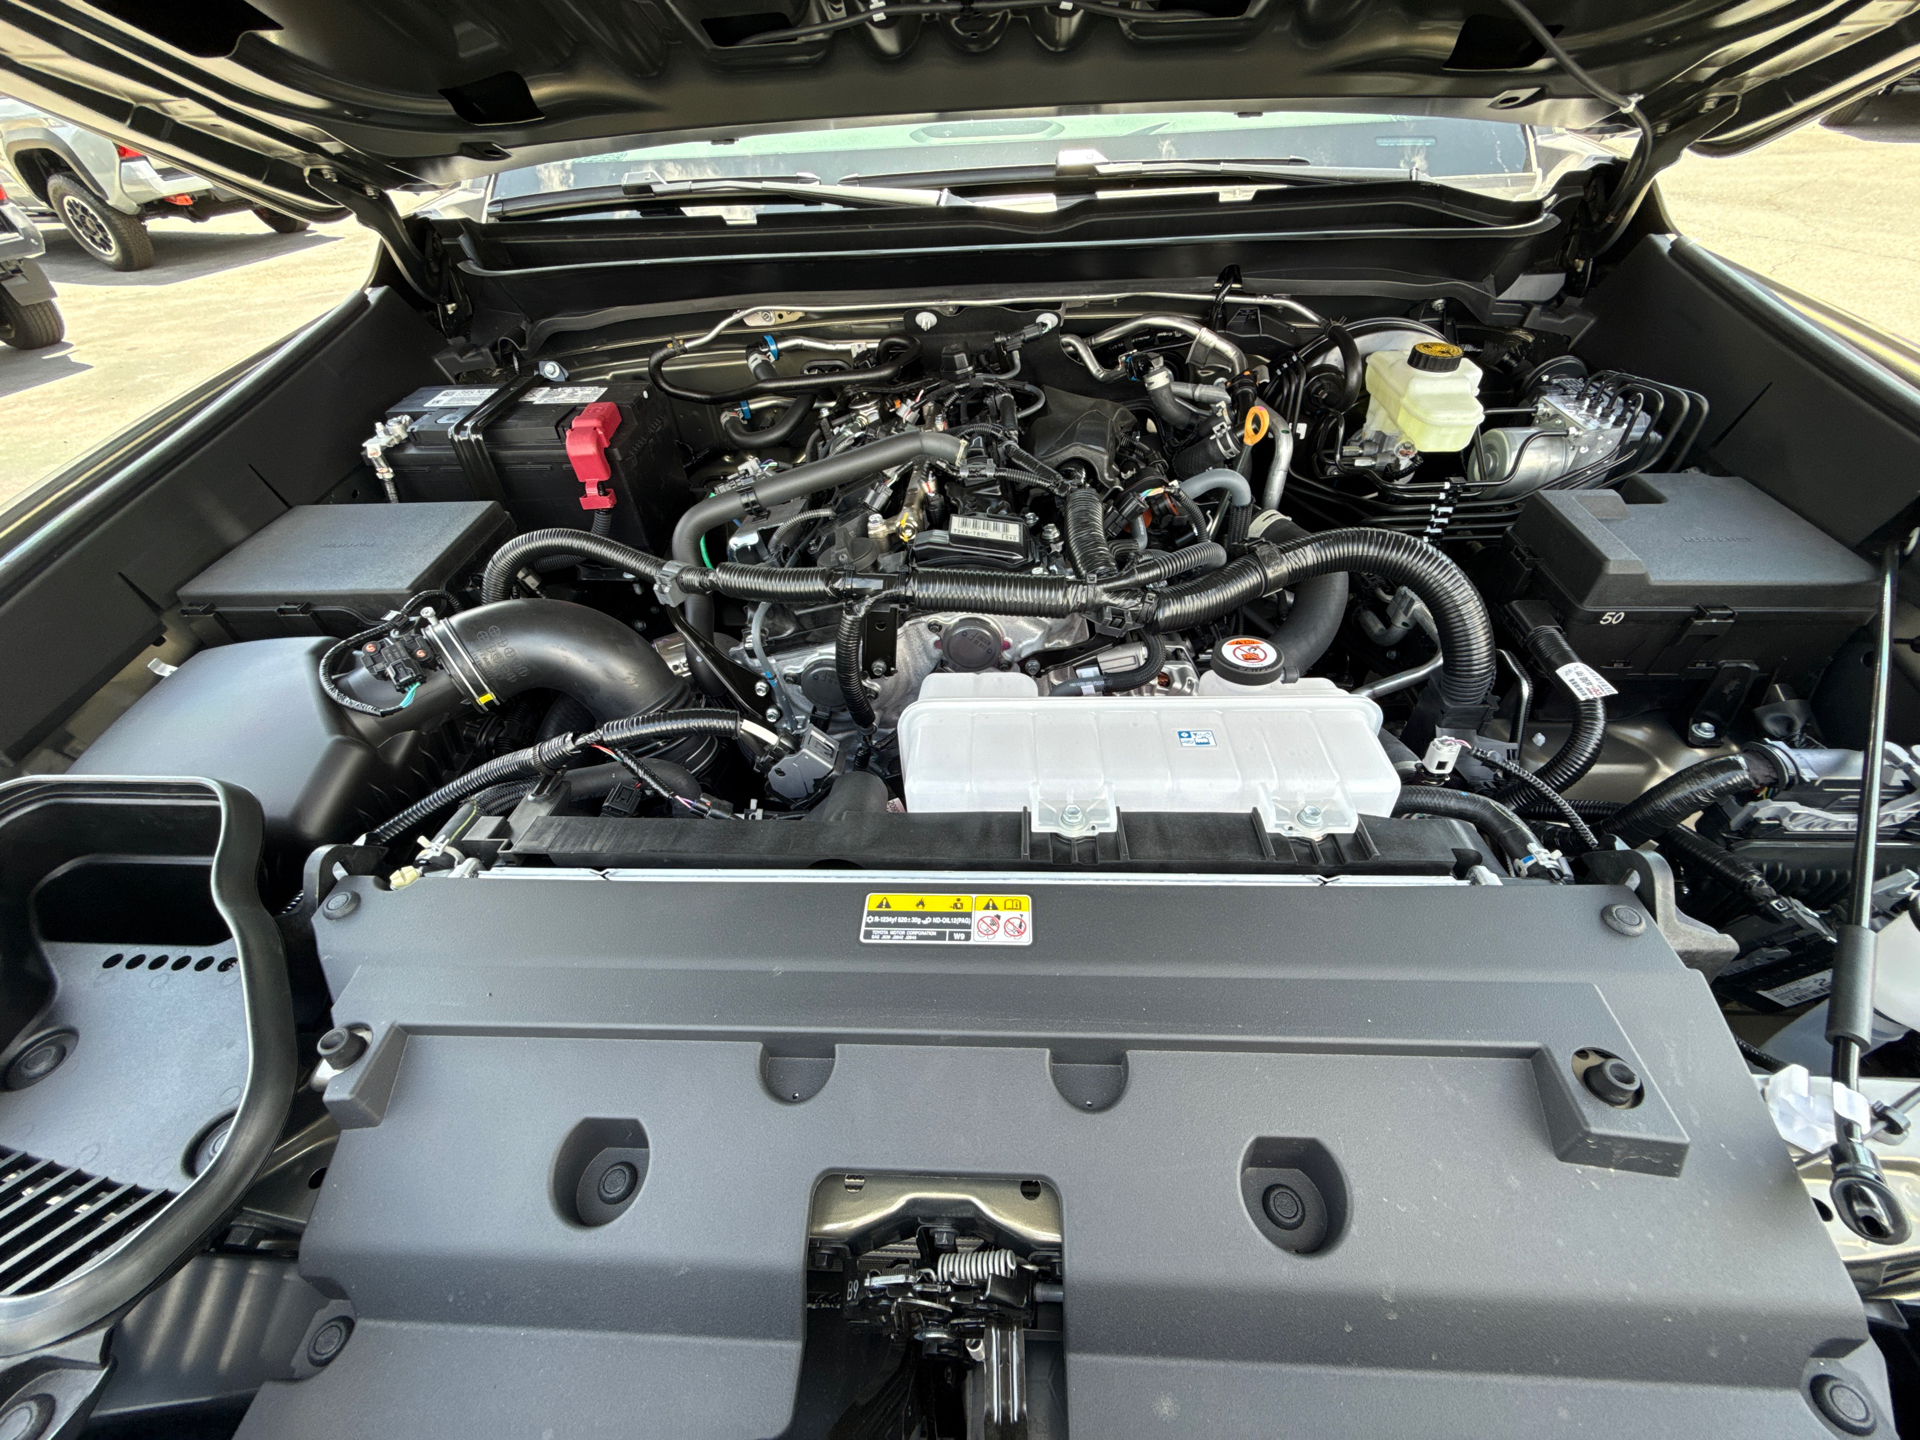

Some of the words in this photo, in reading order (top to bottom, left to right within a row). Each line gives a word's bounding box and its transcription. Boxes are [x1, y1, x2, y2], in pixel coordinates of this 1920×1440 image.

[1599, 611, 1625, 625] 50
[953, 932, 965, 940] W9
[846, 1279, 859, 1301] B9
